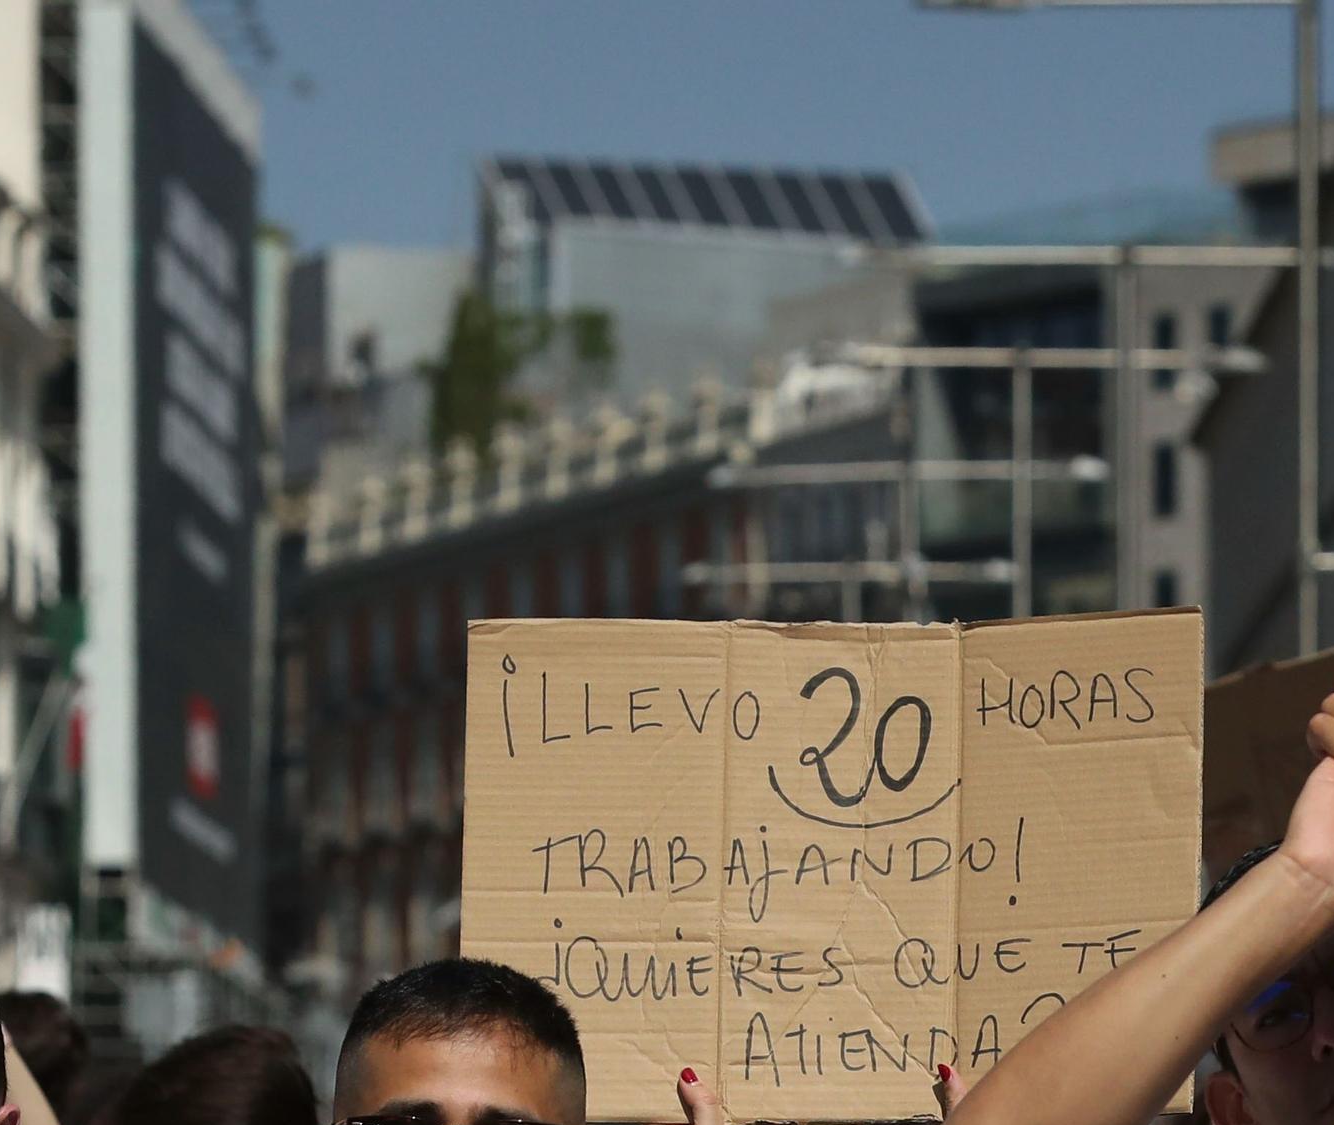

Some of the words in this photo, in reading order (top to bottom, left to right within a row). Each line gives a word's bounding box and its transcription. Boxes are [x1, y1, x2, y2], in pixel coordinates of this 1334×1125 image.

[798, 666, 932, 808] 20
[975, 667, 1156, 731] HORAS
[893, 937, 1033, 988] QUE
[1061, 929, 1143, 975] TE
